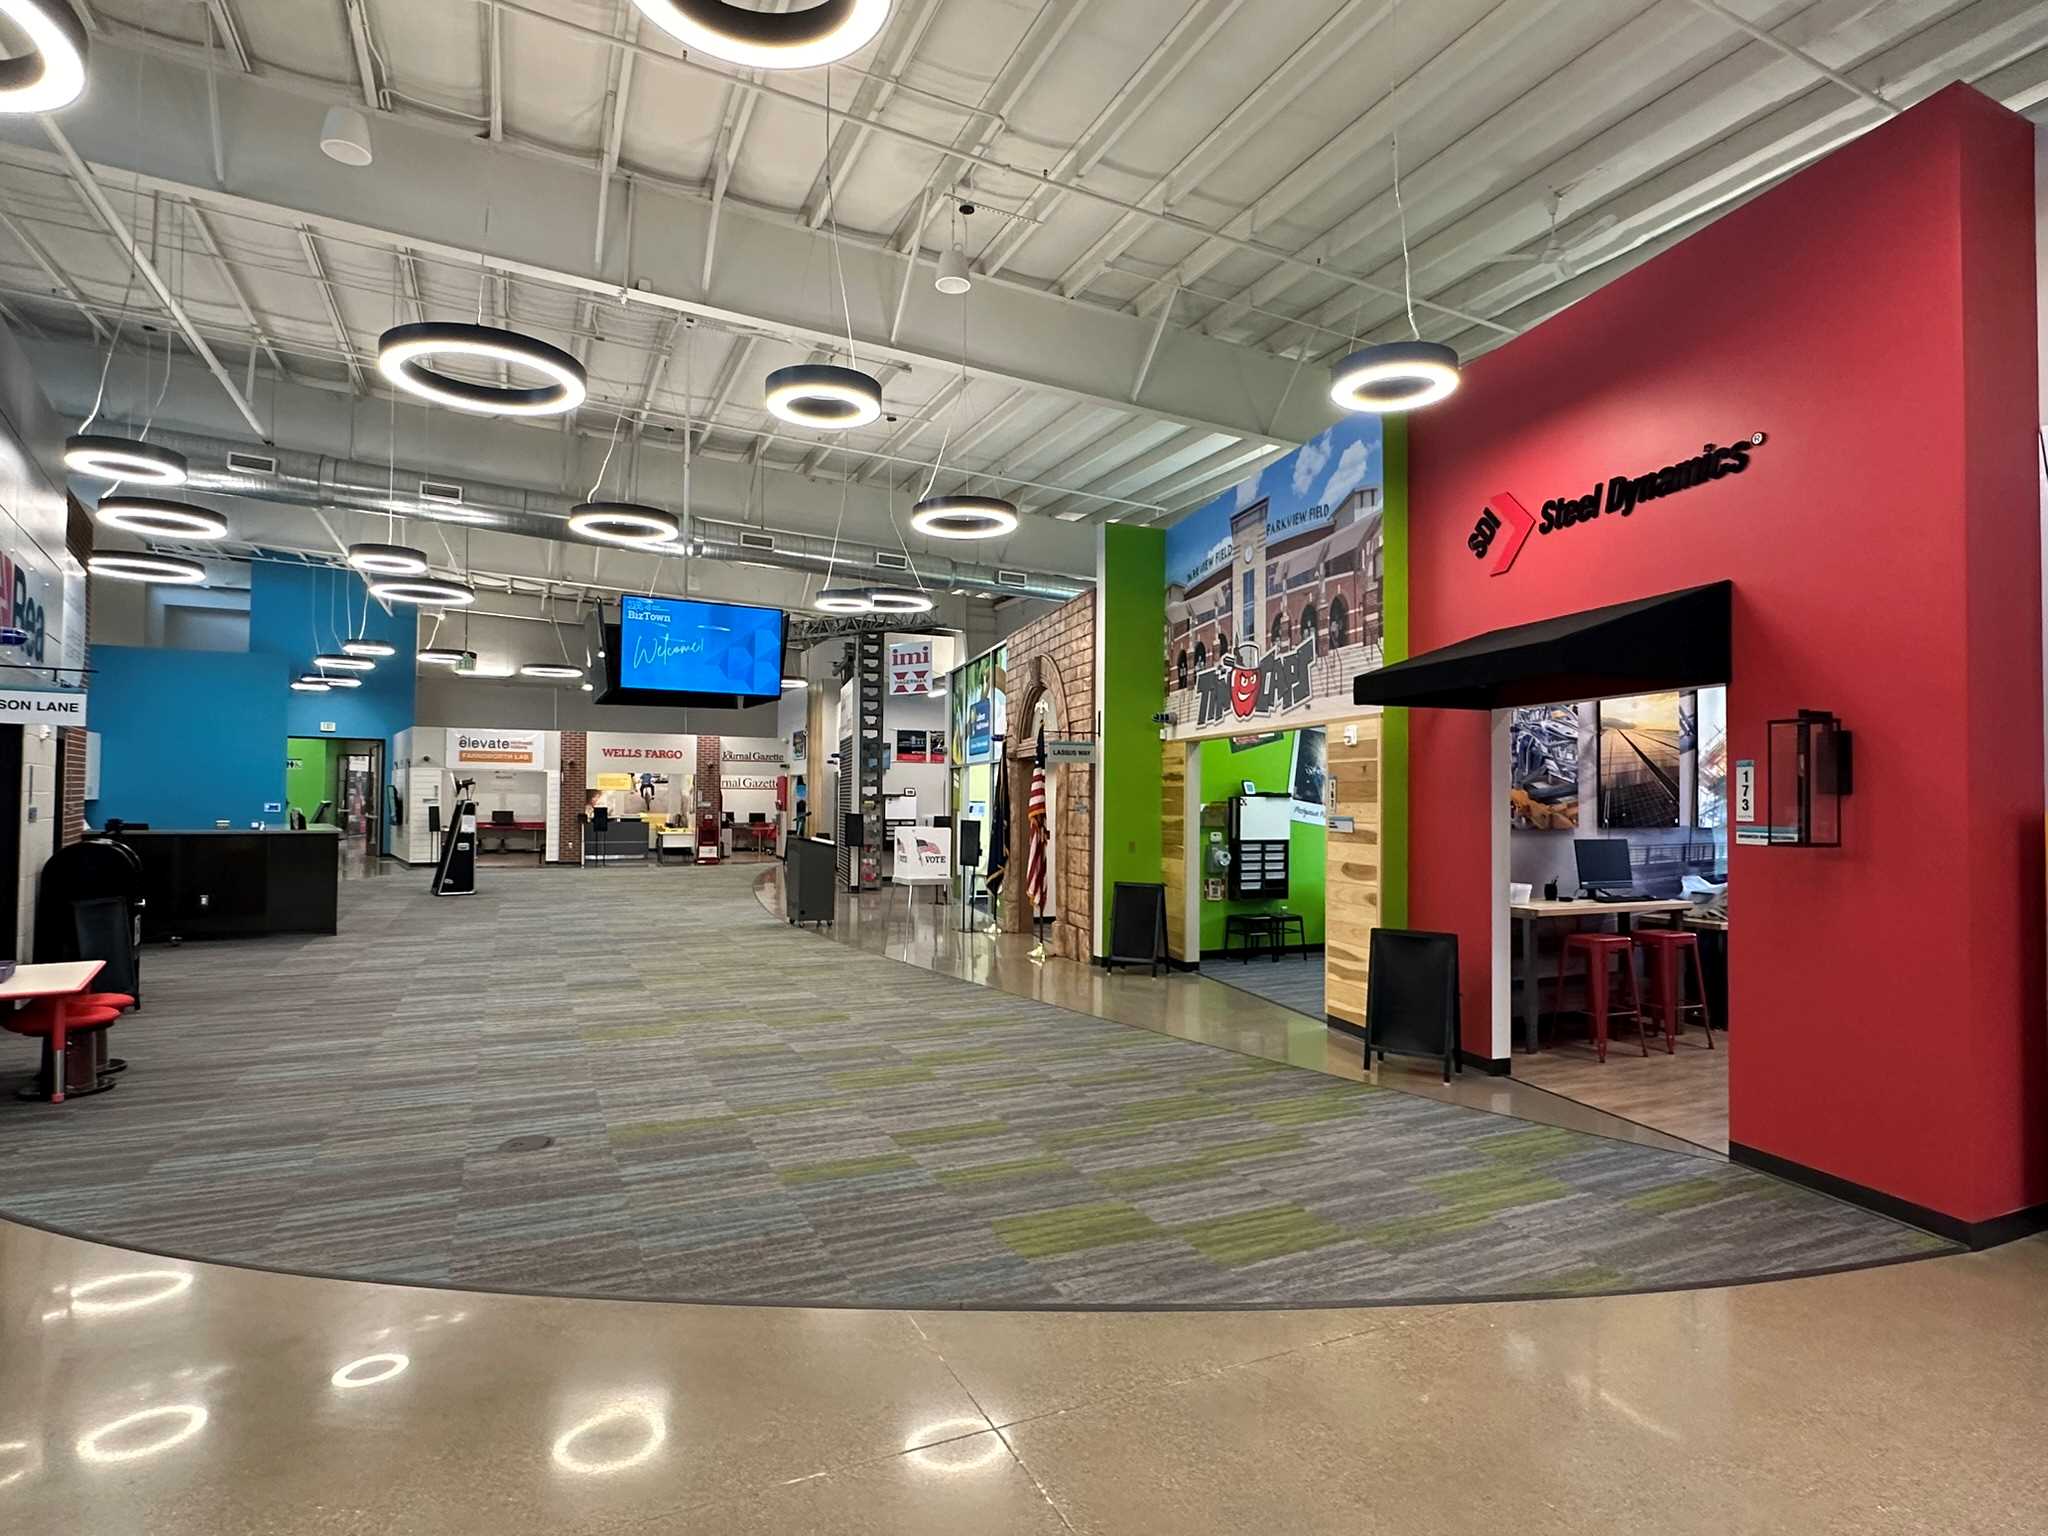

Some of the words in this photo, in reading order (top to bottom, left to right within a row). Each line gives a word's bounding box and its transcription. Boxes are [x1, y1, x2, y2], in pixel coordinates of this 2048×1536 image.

[1538, 482, 1604, 535] Steel
[1604, 441, 1753, 517] Dynamics
[1265, 509, 1308, 537] PARKVIEW
[1308, 503, 1330, 522] FIELD
[1467, 506, 1502, 559] SDI
[1215, 544, 1233, 565] FIELD
[627, 609, 671, 622] BizTown
[892, 646, 929, 666] imi
[36, 701, 80, 713] LANE
[602, 748, 643, 758] WELLS
[645, 749, 683, 760] FARGO
[721, 751, 751, 762] Journal
[752, 752, 784, 762] Gazette
[1741, 769, 1750, 811] 173
[925, 855, 947, 864] VOTE
